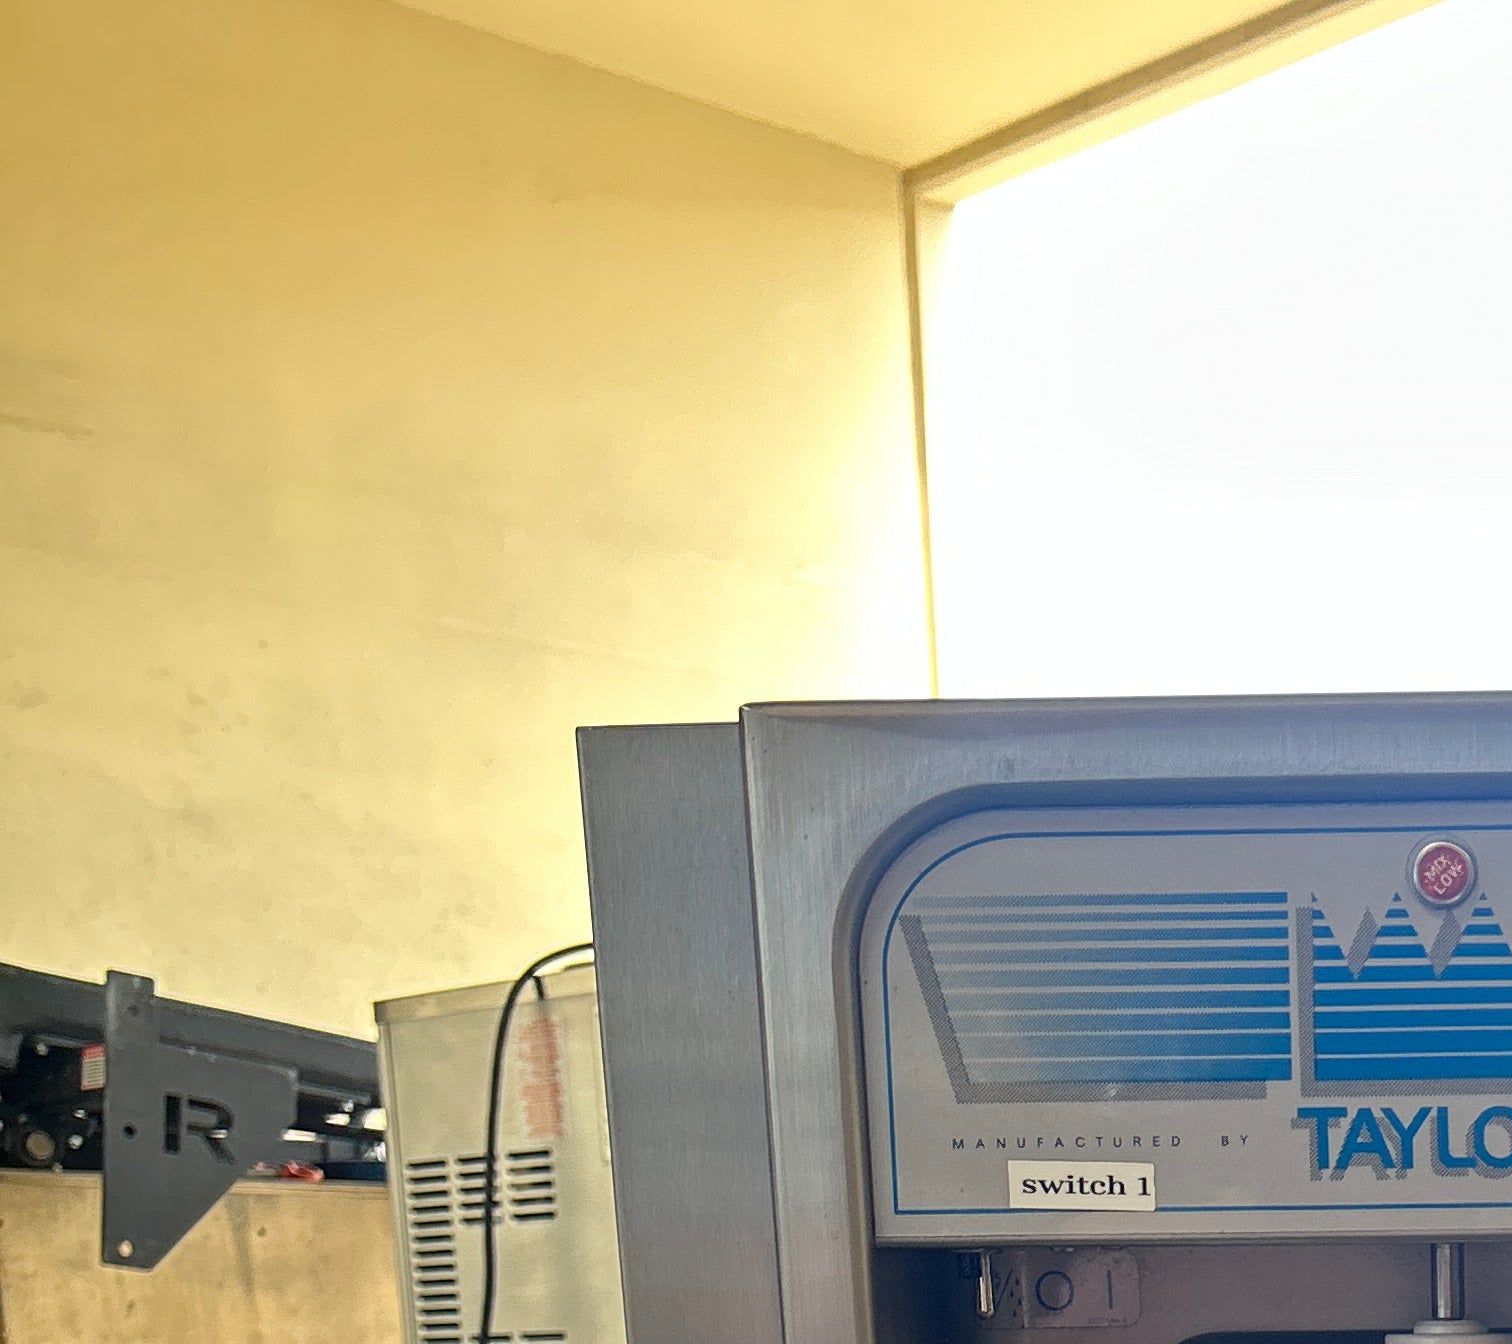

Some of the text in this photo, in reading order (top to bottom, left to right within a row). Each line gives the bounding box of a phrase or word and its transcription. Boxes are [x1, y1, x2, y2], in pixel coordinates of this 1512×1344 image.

[1424, 855, 1452, 881] MIX
[1434, 864, 1464, 894] LOW
[952, 1135, 1249, 1150] MANUFACTURED BY
[1022, 1175, 1152, 1197] switch 1
